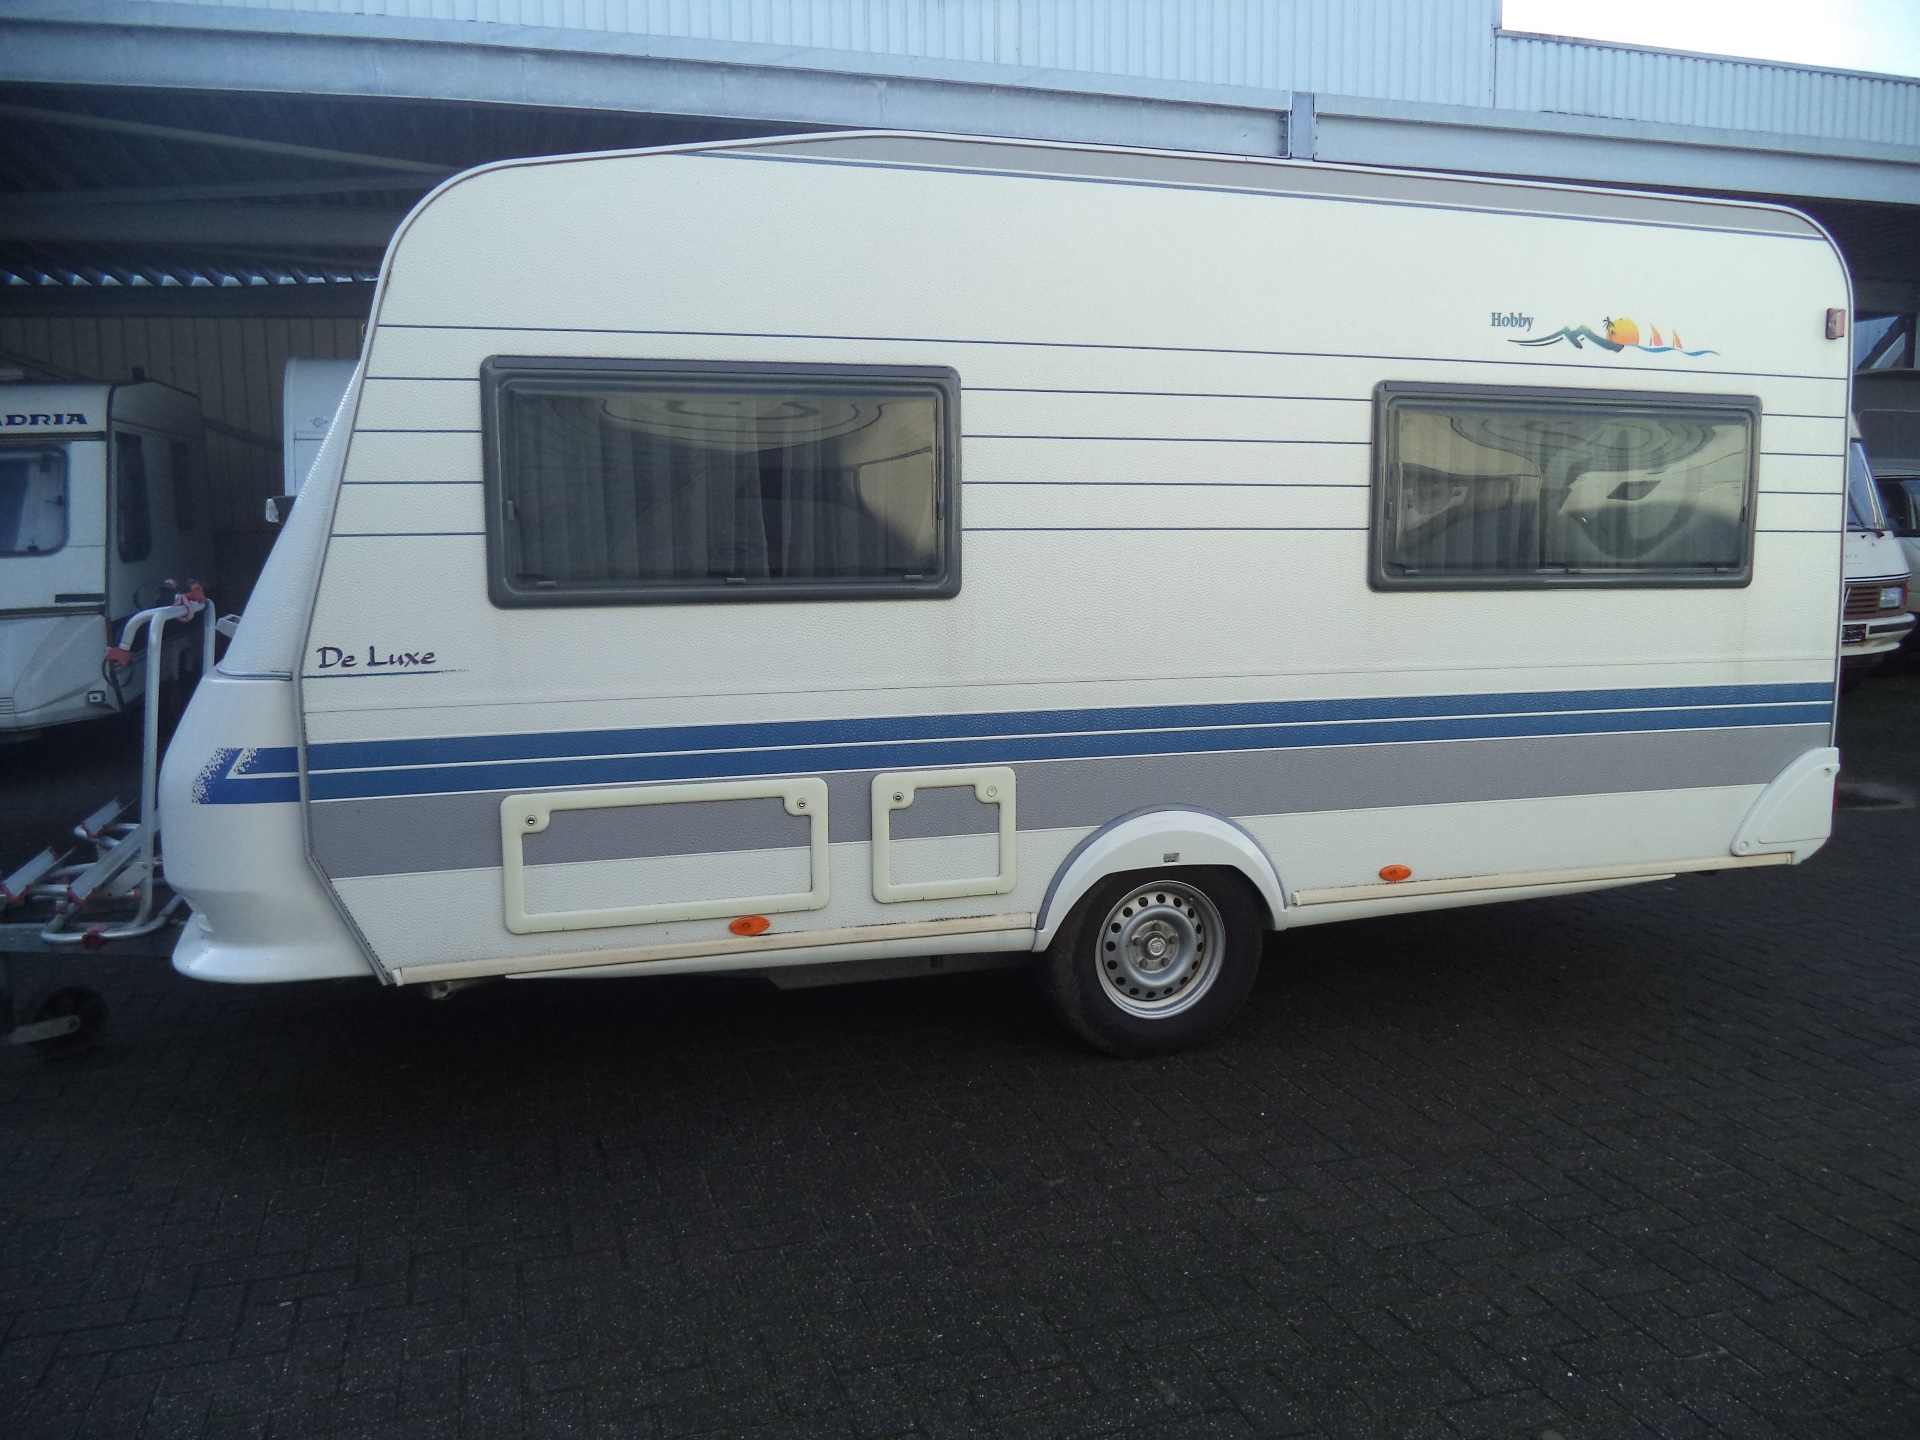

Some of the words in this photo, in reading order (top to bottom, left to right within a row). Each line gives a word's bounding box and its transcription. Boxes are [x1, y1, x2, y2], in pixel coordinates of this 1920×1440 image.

[1490, 312, 1535, 332] Hobby
[0, 413, 88, 427] DRIA
[316, 646, 357, 669] De
[367, 645, 437, 668] Luxe
